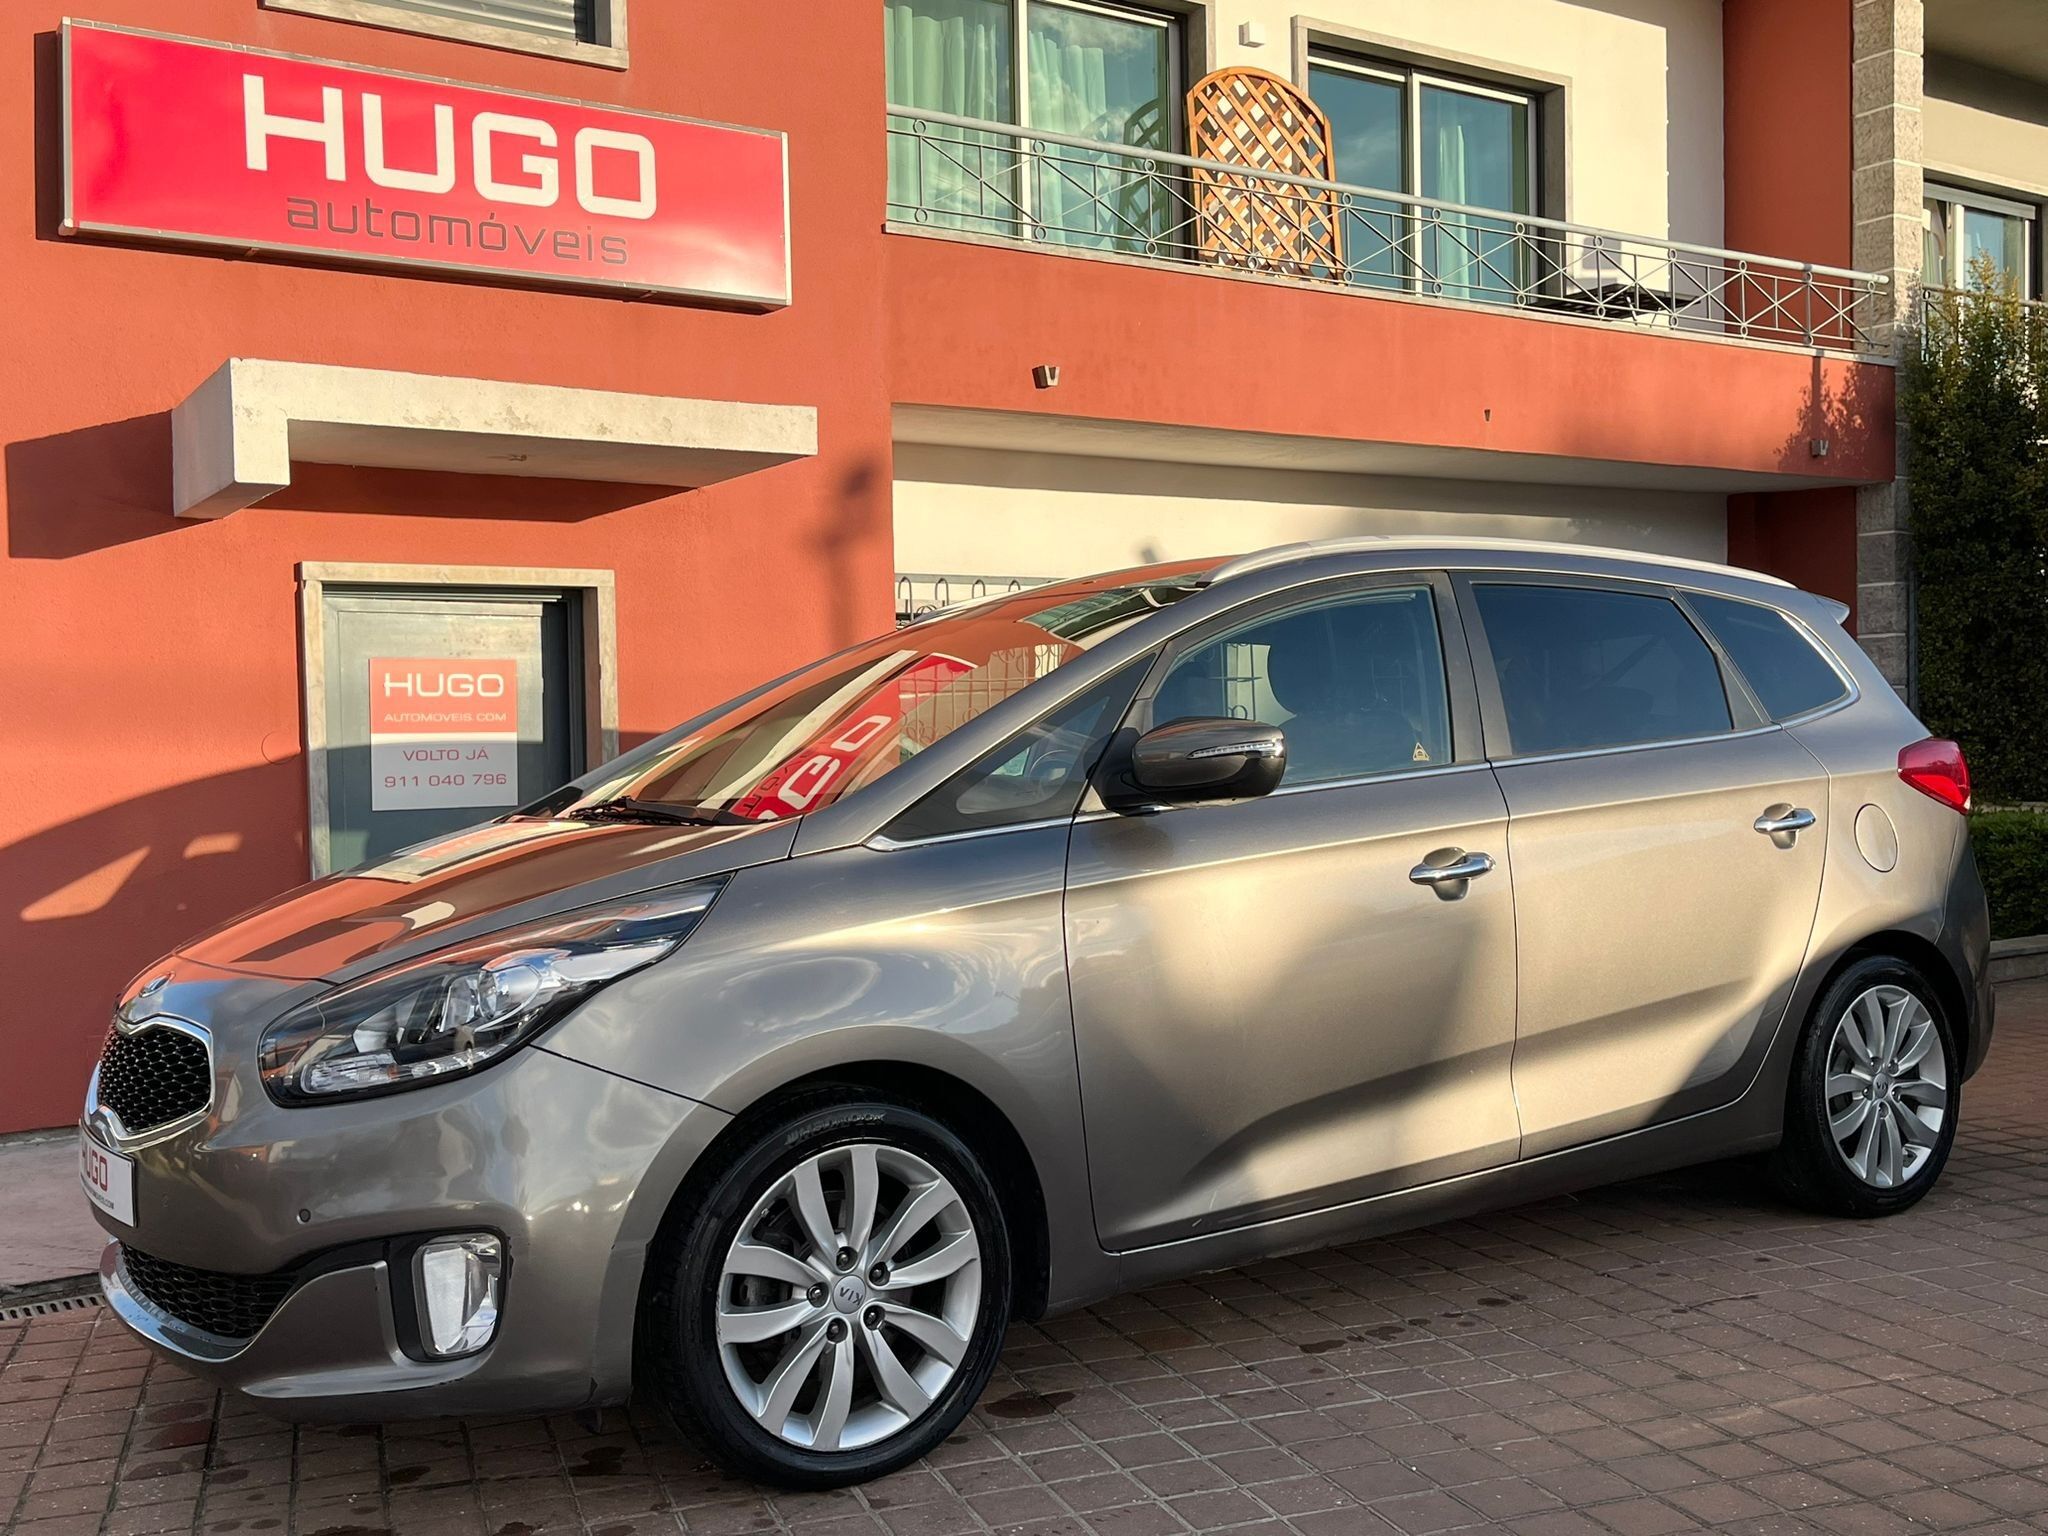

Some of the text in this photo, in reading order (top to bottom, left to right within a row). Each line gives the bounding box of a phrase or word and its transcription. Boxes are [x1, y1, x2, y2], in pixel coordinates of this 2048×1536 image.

[243, 73, 658, 221] HUGO
[286, 196, 629, 265] automóveis
[383, 672, 505, 697] HUGO
[402, 745, 489, 762] VOLTO JÁ
[384, 773, 507, 789] 911 040 796
